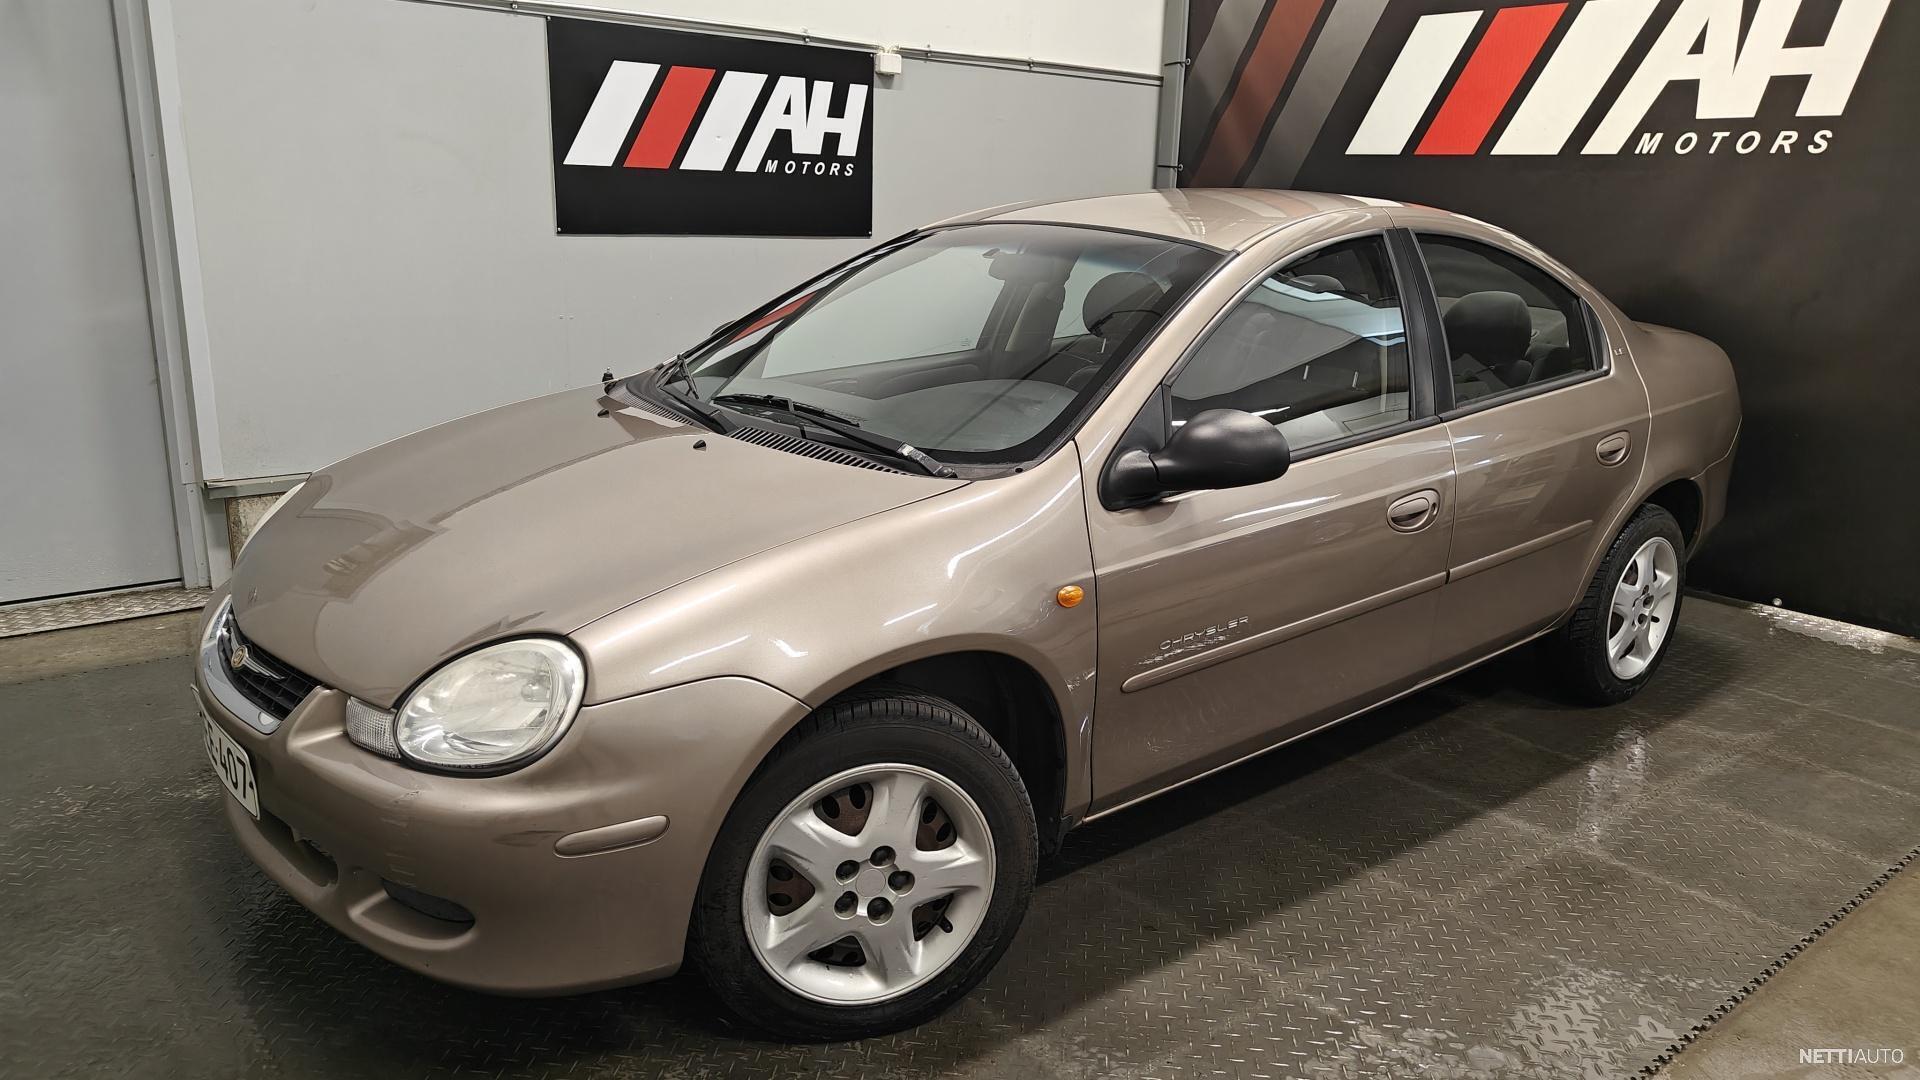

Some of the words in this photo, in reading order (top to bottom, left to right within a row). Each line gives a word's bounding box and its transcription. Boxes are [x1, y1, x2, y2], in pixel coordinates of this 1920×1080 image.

[1580, 0, 1891, 154] AH
[735, 75, 869, 172] AH
[1634, 129, 1836, 155] MOTORS
[764, 159, 856, 177] MOTORS
[1159, 615, 1249, 650] CHRYSLER
